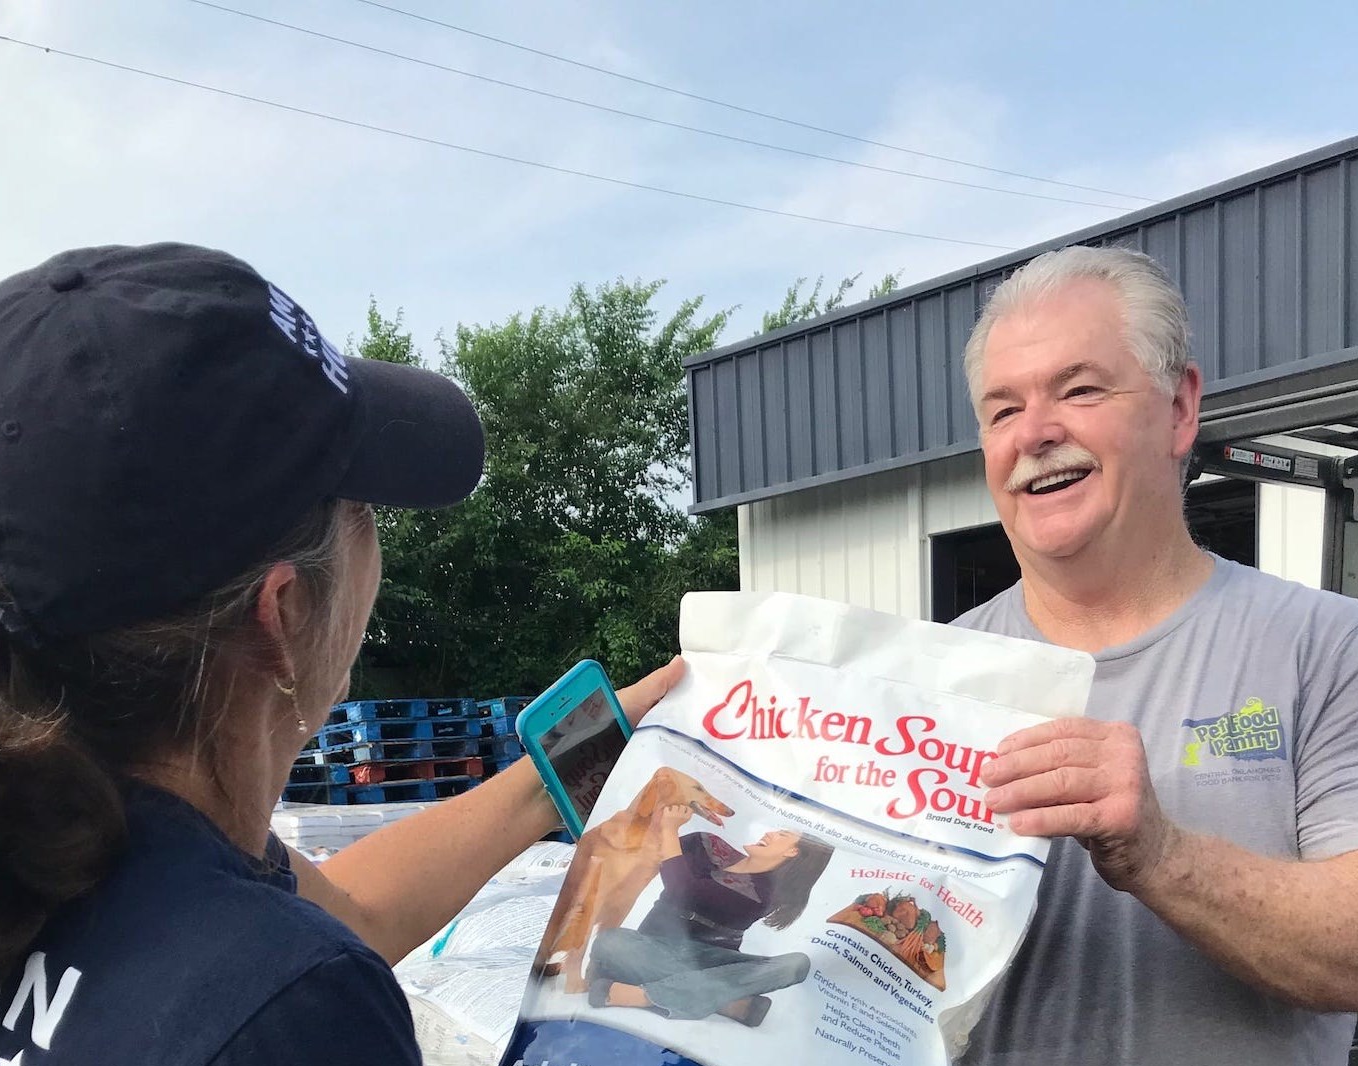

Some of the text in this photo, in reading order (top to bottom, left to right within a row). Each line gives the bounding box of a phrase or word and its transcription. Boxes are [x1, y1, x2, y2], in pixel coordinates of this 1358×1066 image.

[702, 679, 873, 745] Chicken
[1194, 707, 1279, 743] Pet Food
[1210, 728, 1281, 758] Pantry
[813, 755, 897, 788] for the
[777, 807, 813, 830] Nutrition,
[825, 827, 843, 839] also
[842, 833, 868, 849] about
[869, 843, 907, 863] Comfort,
[908, 855, 930, 869] Love
[931, 863, 949, 873] and
[925, 813, 995, 834] Brand Dog Food
[850, 868, 985, 929] Holistic for Health
[811, 936, 935, 1024] Duck, Salmon and Vegetables
[814, 969, 848, 997] Enriched
[826, 929, 933, 1009] Contains Chicken, Turkey,
[817, 984, 912, 1043] Vitamin E and Selenium
[825, 1002, 901, 1050] Helps Clean Teeth
[814, 1026, 857, 1052] Naturally
[821, 1014, 901, 1061] and Reduce Plaque
